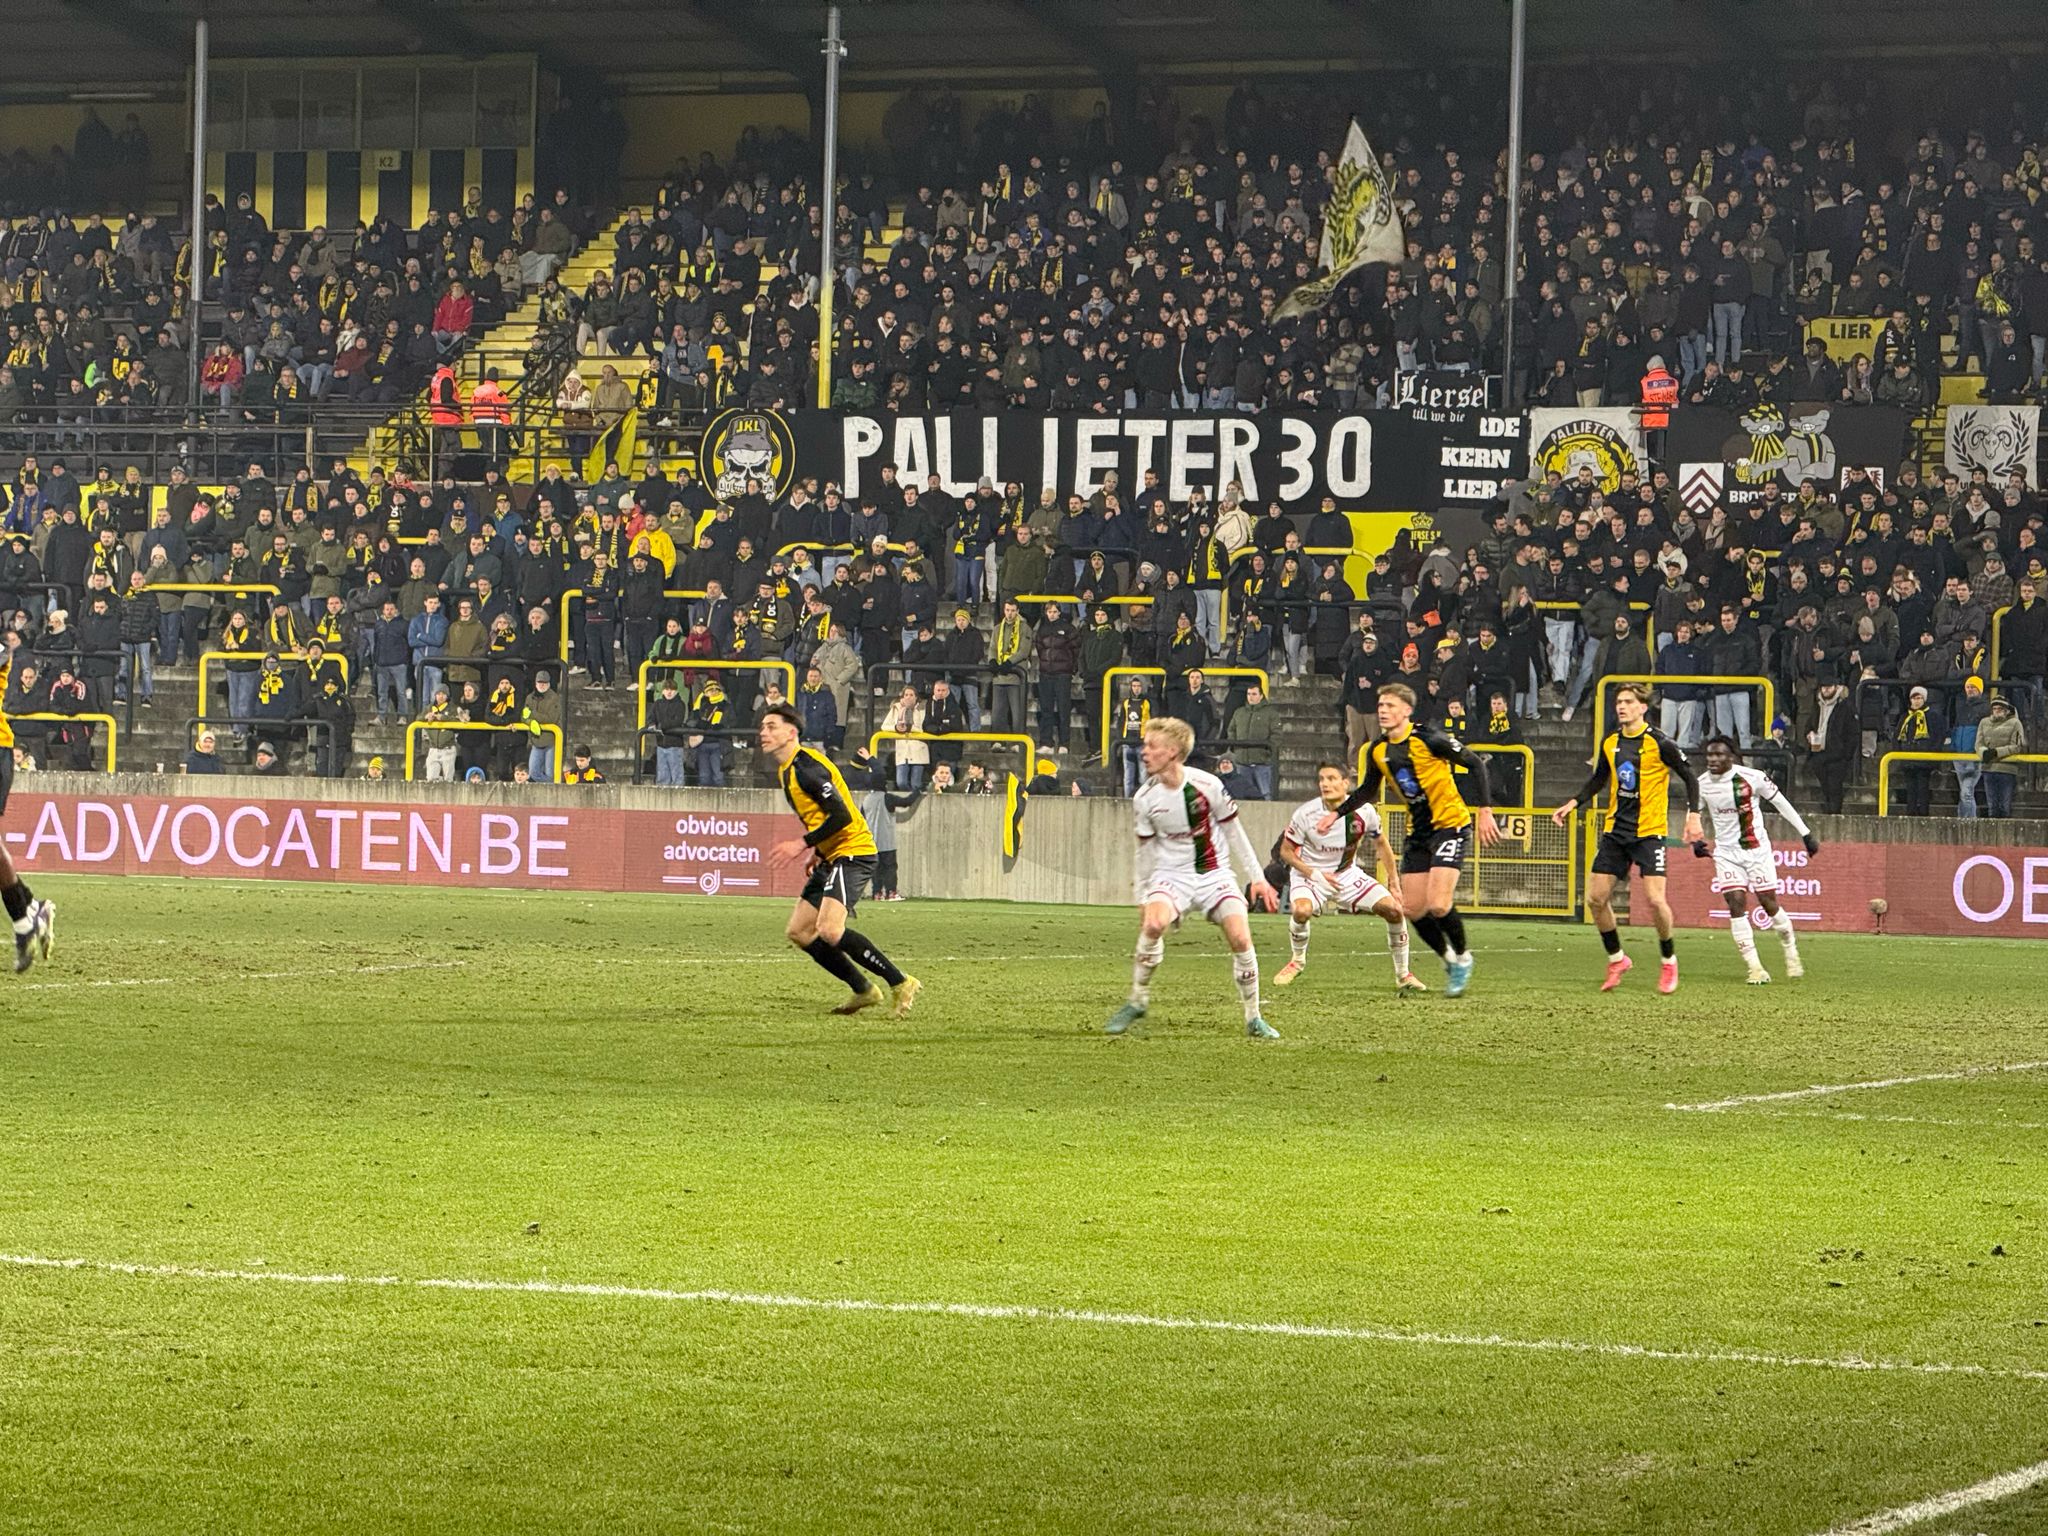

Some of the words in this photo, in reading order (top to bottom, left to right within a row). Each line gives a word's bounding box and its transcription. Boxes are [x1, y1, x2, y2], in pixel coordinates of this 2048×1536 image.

[1830, 323, 1872, 339] LIER
[1400, 374, 1484, 409] Lierse
[736, 419, 761, 433] JKL
[1412, 408, 1428, 421] till
[1431, 410, 1446, 422] we
[1450, 411, 1466, 423] die
[1550, 421, 1616, 444] PALLIETER
[843, 416, 1260, 501] PALLIETER
[1279, 416, 1372, 501] 30
[1440, 447, 1511, 469] KERN
[1443, 479, 1507, 499] LIER
[675, 814, 749, 836] obvious
[1512, 818, 1526, 837] 8
[6, 801, 569, 877] -ADVOCATEN.BE
[664, 841, 760, 863] advocaten
